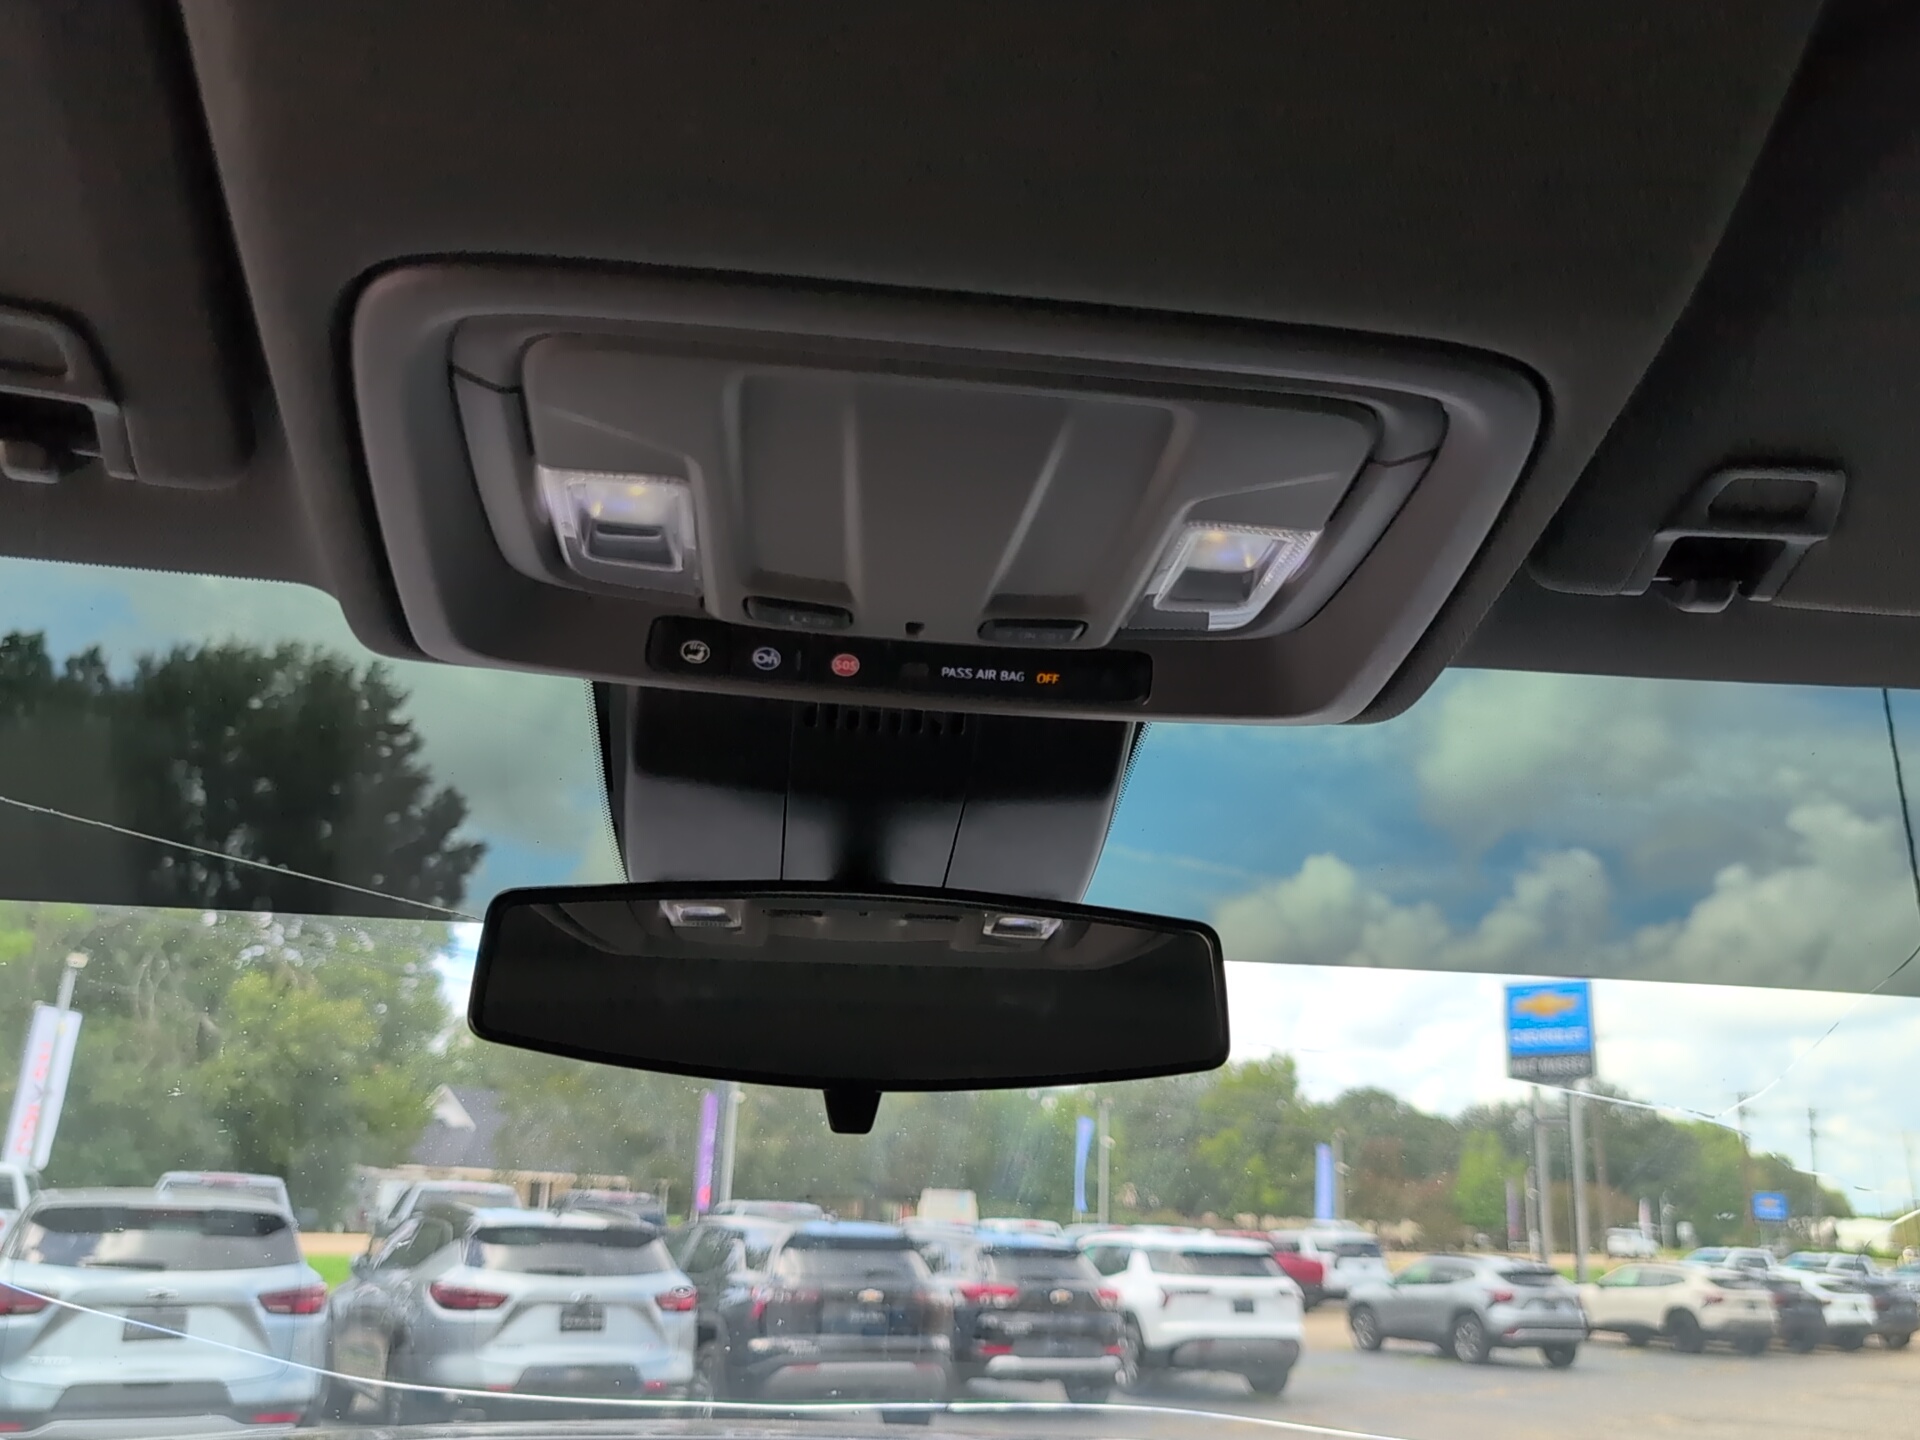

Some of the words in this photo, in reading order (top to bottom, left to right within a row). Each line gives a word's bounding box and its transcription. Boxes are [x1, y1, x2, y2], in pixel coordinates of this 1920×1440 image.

[835, 659, 857, 672] SOS
[941, 666, 973, 680] PASS
[975, 668, 997, 681] AIR
[999, 670, 1025, 683] BAG
[1036, 672, 1060, 685] OFF
